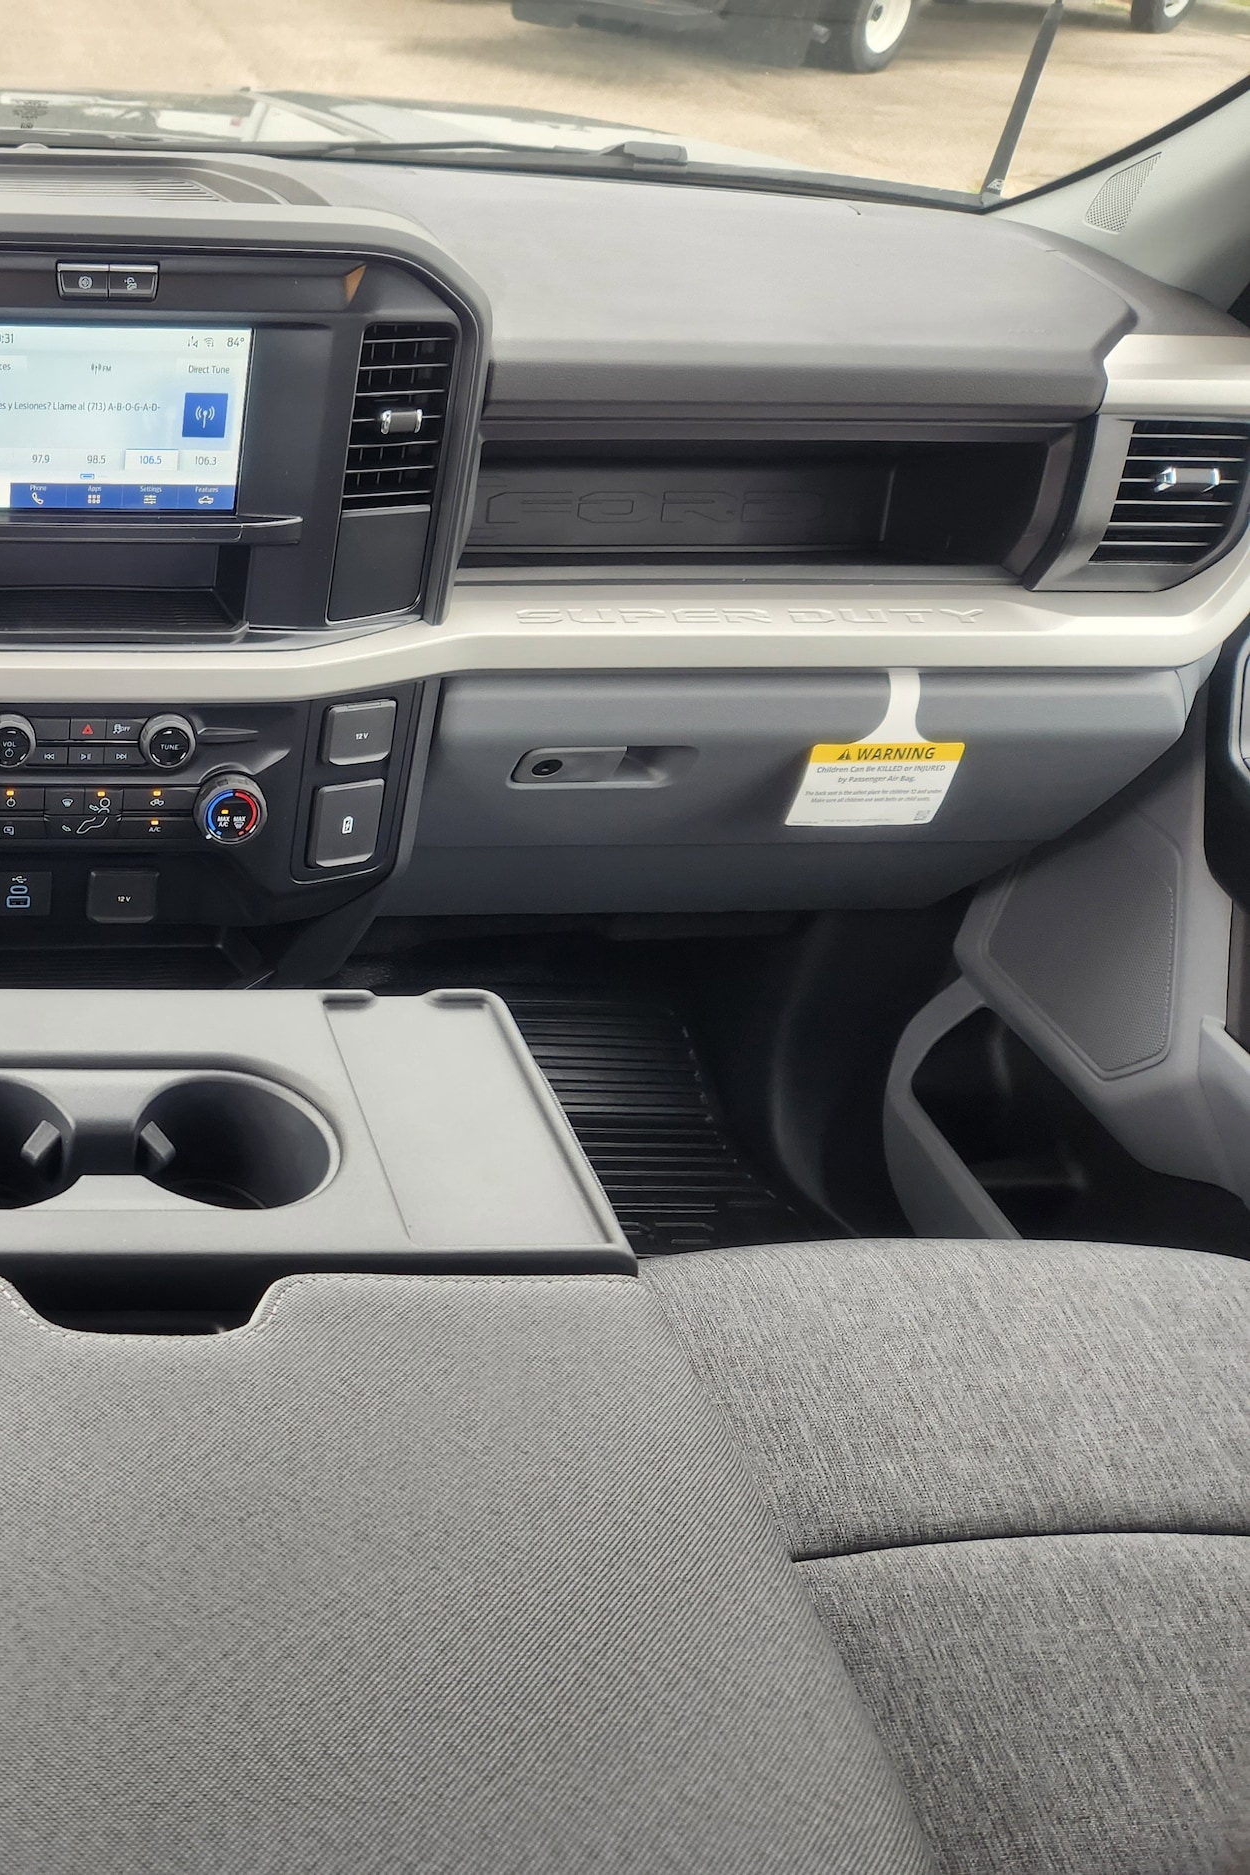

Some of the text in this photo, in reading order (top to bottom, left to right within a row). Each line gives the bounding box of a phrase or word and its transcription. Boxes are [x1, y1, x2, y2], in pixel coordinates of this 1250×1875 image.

[226, 336, 245, 348] 84°
[188, 365, 230, 375] Direct Tune
[8, 402, 13, 411] y
[14, 401, 52, 410] Lesiones?
[52, 402, 77, 411] Llame
[78, 402, 85, 411] al
[87, 402, 106, 412] (713)
[32, 454, 50, 464] 97.9
[86, 455, 106, 464] 98.5
[139, 455, 162, 465] 106.5
[194, 456, 217, 466] 106.3
[87, 485, 102, 494] Apps
[139, 485, 162, 494] Settings
[485, 490, 826, 525] FORD
[515, 607, 985, 625] SUPER DUTY
[857, 747, 936, 761] WARNING
[865, 765, 876, 773] Be
[913, 764, 946, 773] INJURED
[837, 776, 848, 784] by
